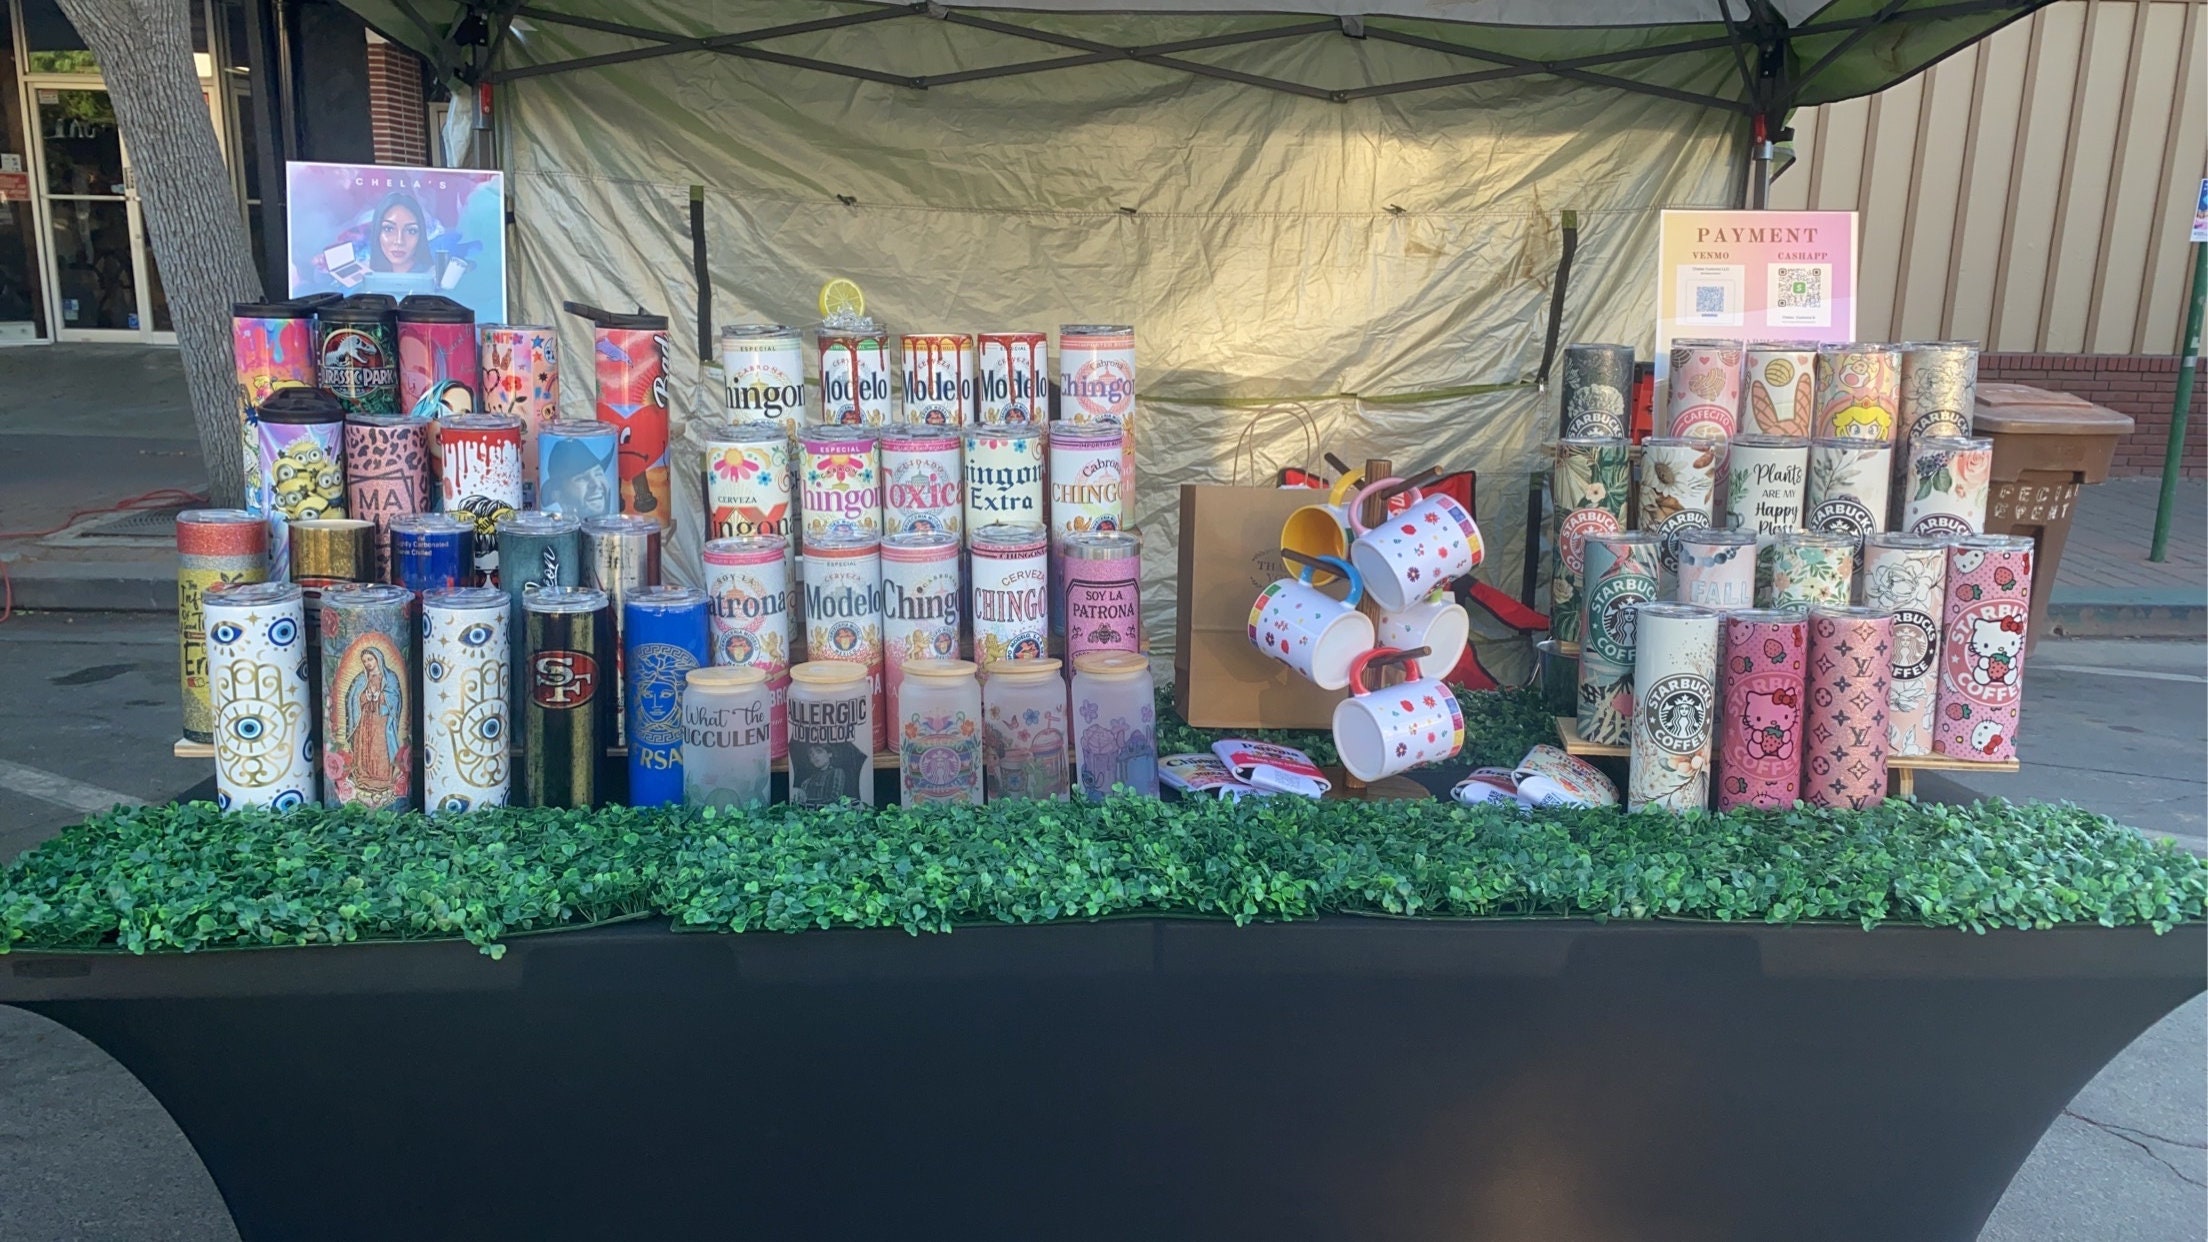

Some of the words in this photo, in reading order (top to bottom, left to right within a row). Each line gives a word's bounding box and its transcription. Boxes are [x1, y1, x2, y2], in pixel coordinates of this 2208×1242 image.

[355, 177, 447, 190] CHELA'S
[1697, 227, 1819, 243] PAYMENT
[1693, 251, 1729, 260] VENMO
[1777, 251, 1828, 261] CASHAPP
[918, 358, 952, 370] CEVEZA
[997, 357, 1029, 366] CEVEZA
[362, 368, 395, 387] PARK
[1061, 372, 1135, 404] Chingo
[1683, 410, 1730, 426] CAFECITO
[1910, 411, 1969, 437] STARBUCK
[1753, 463, 1802, 485] Plants
[358, 490, 402, 510] MA
[717, 495, 758, 504] CERVEZA
[971, 487, 1033, 512] Extra
[1762, 490, 1780, 498] ARE
[1783, 490, 1796, 498] MY
[1755, 502, 1799, 524] Happy
[824, 571, 861, 582] CERVEZA
[805, 582, 881, 620] Modelo
[1085, 590, 1106, 601] SOY
[1109, 590, 1123, 601] LA
[1690, 580, 1750, 605] FALL
[1073, 602, 1135, 619] PATRONA
[1648, 677, 1713, 710] STARBUCKS
[684, 704, 731, 727] What
[732, 701, 765, 723] the
[788, 696, 867, 727] ALLERGIC
[808, 724, 855, 743] COLOR
[1654, 728, 1707, 751] COFFEE
